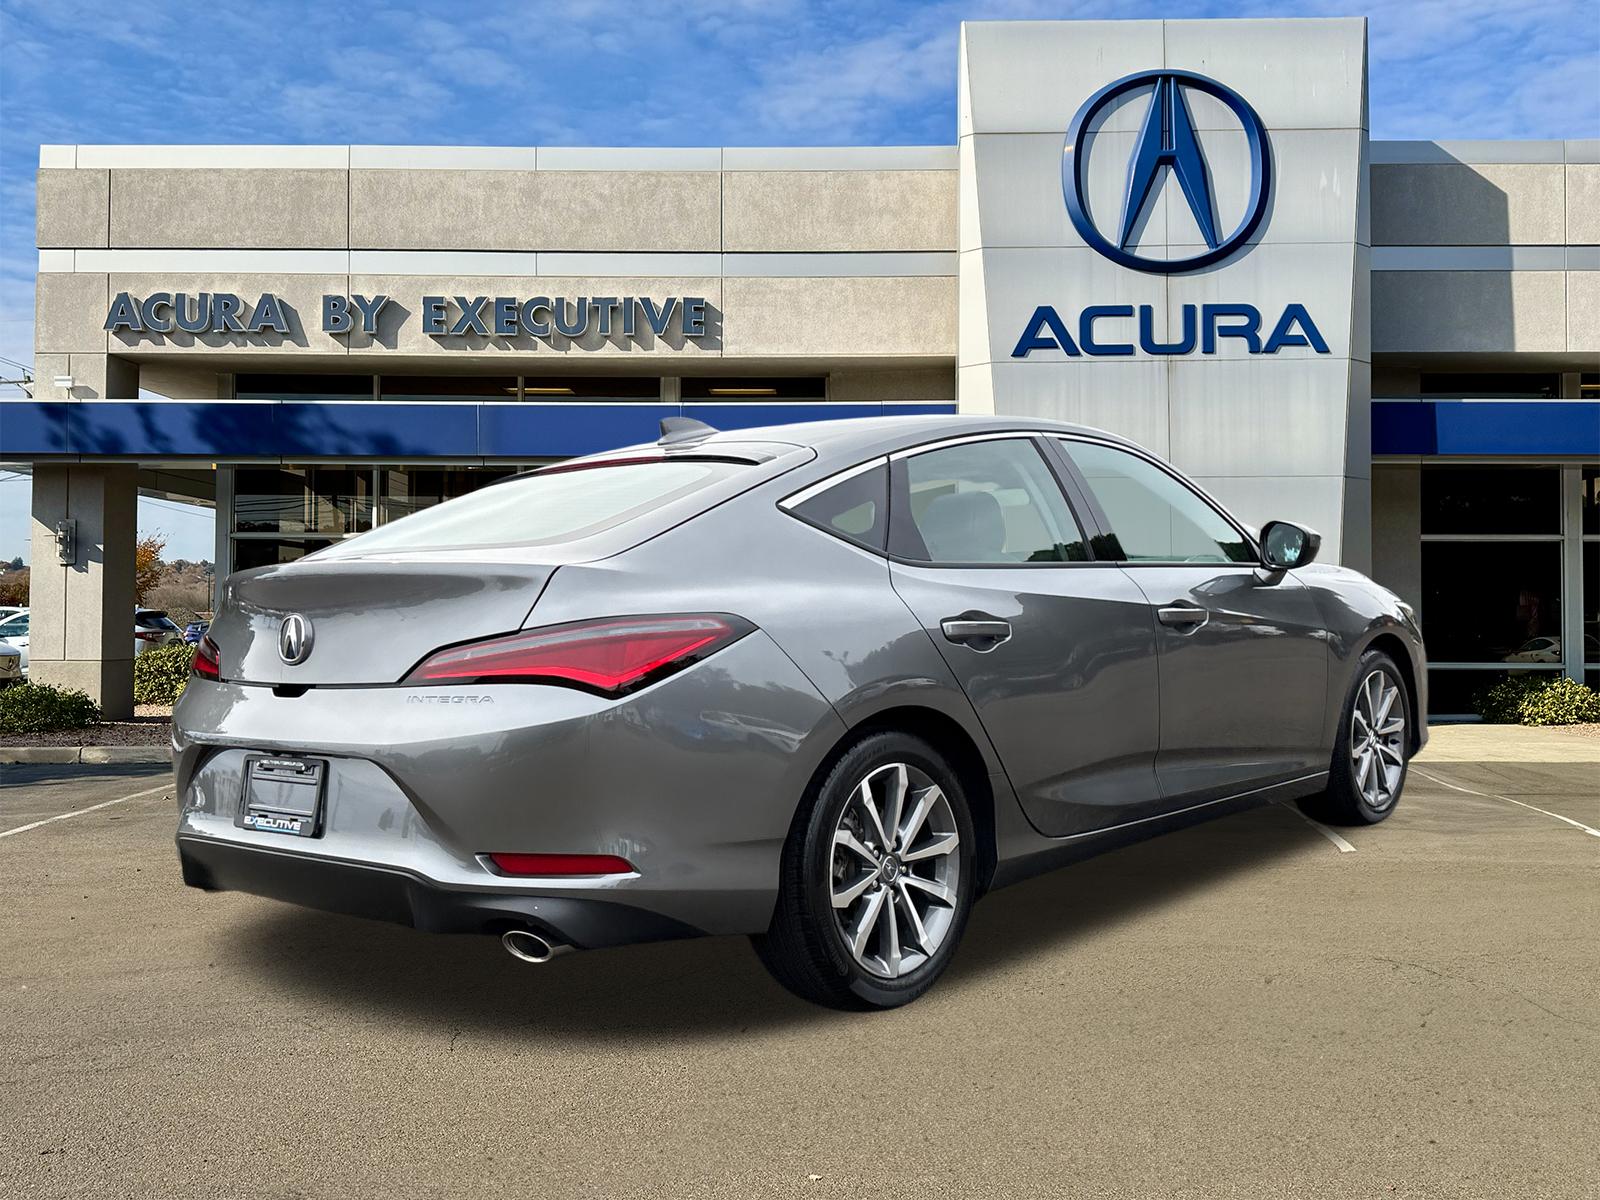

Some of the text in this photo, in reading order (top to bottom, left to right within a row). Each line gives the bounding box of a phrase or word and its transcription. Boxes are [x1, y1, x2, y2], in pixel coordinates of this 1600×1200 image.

[103, 292, 706, 337] ACURA BY EXECUTIVE
[1011, 303, 1331, 357] ACURA
[407, 695, 494, 704] INTEGRA
[244, 815, 302, 831] EXECUTIVE
